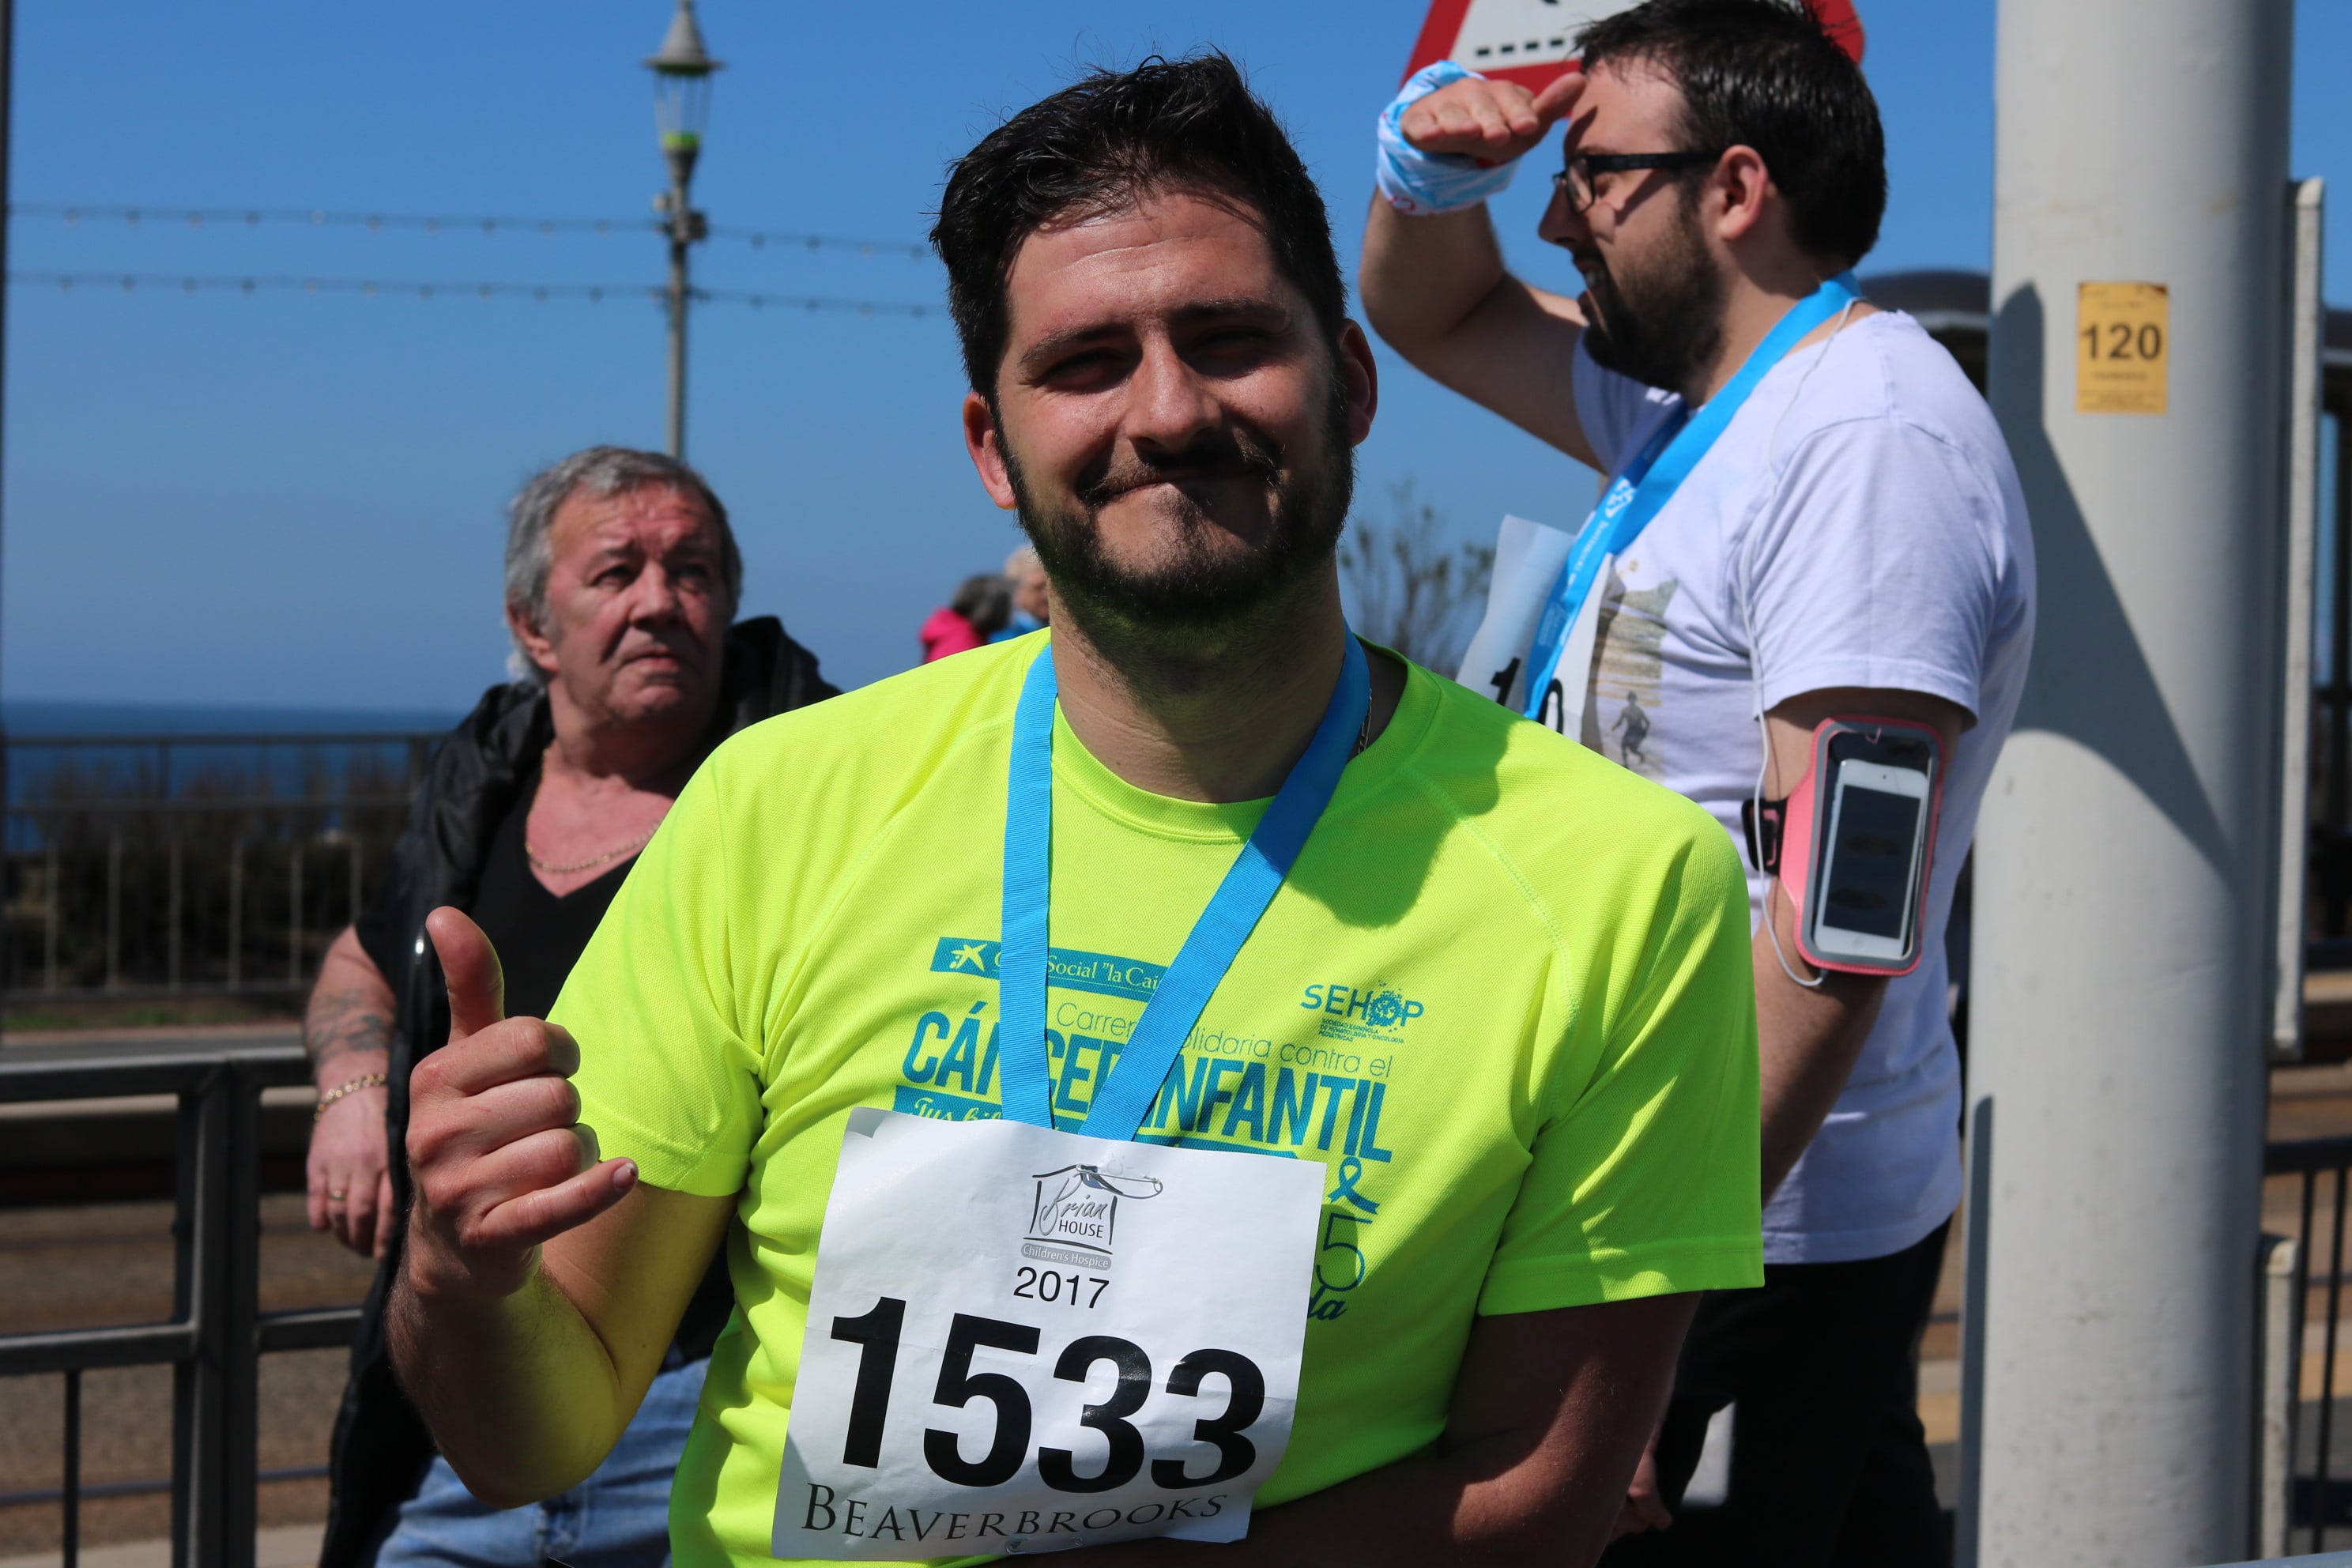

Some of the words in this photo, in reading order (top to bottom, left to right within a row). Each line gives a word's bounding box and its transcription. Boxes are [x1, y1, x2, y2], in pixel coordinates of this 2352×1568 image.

[2081, 322, 2162, 360] 120
[1048, 955, 1098, 978] Social
[1300, 984, 1425, 1027] SEHOP
[1057, 1002, 1136, 1038] Carrer
[1182, 1027, 1272, 1058] olidaria
[1280, 1042, 1361, 1073] contra
[1370, 1054, 1393, 1078] el
[1140, 1054, 1393, 1163] NFANTIL
[1038, 1173, 1108, 1236] Brian
[1058, 1219, 1104, 1238] HOUSE
[1071, 1252, 1109, 1269] Hospice
[1013, 1266, 1110, 1310] 2017
[830, 1296, 1266, 1494] 1533
[801, 1482, 1228, 1543] BEAVERBROOKS
